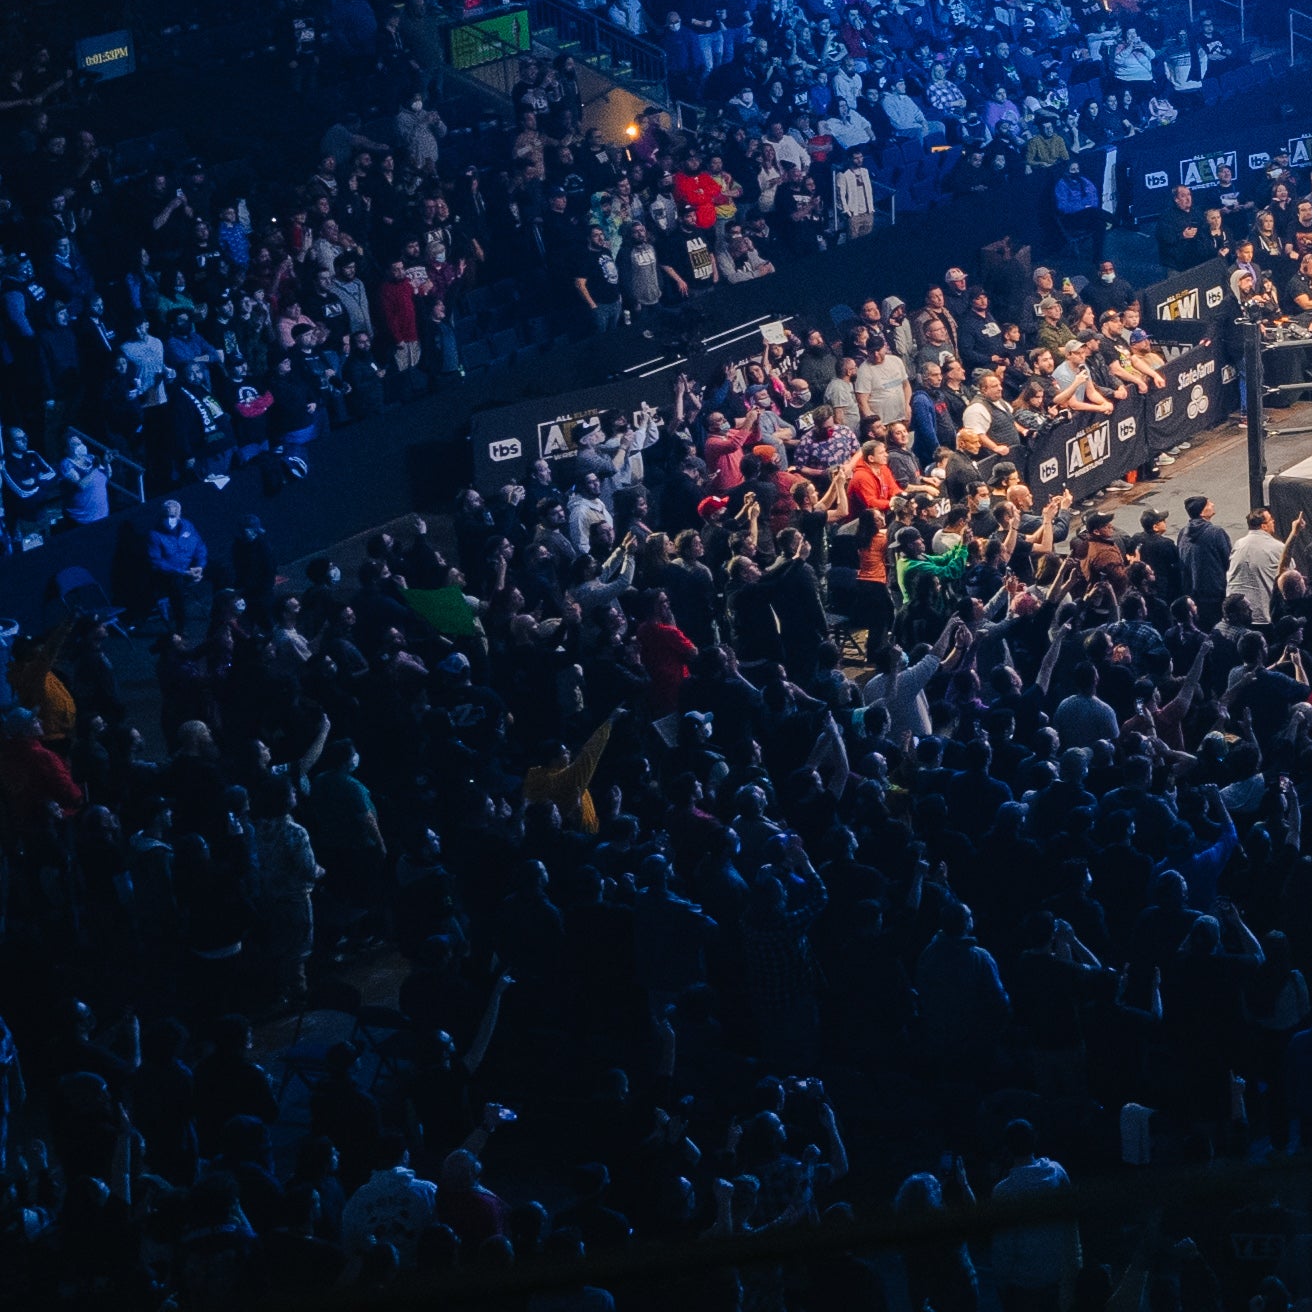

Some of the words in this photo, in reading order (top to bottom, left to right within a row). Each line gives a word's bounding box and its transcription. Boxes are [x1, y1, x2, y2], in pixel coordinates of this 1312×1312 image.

[1184, 155, 1233, 186] AEW
[1162, 294, 1197, 320] AEW
[1178, 360, 1215, 389] StateFarm
[1069, 427, 1109, 472] AEW
